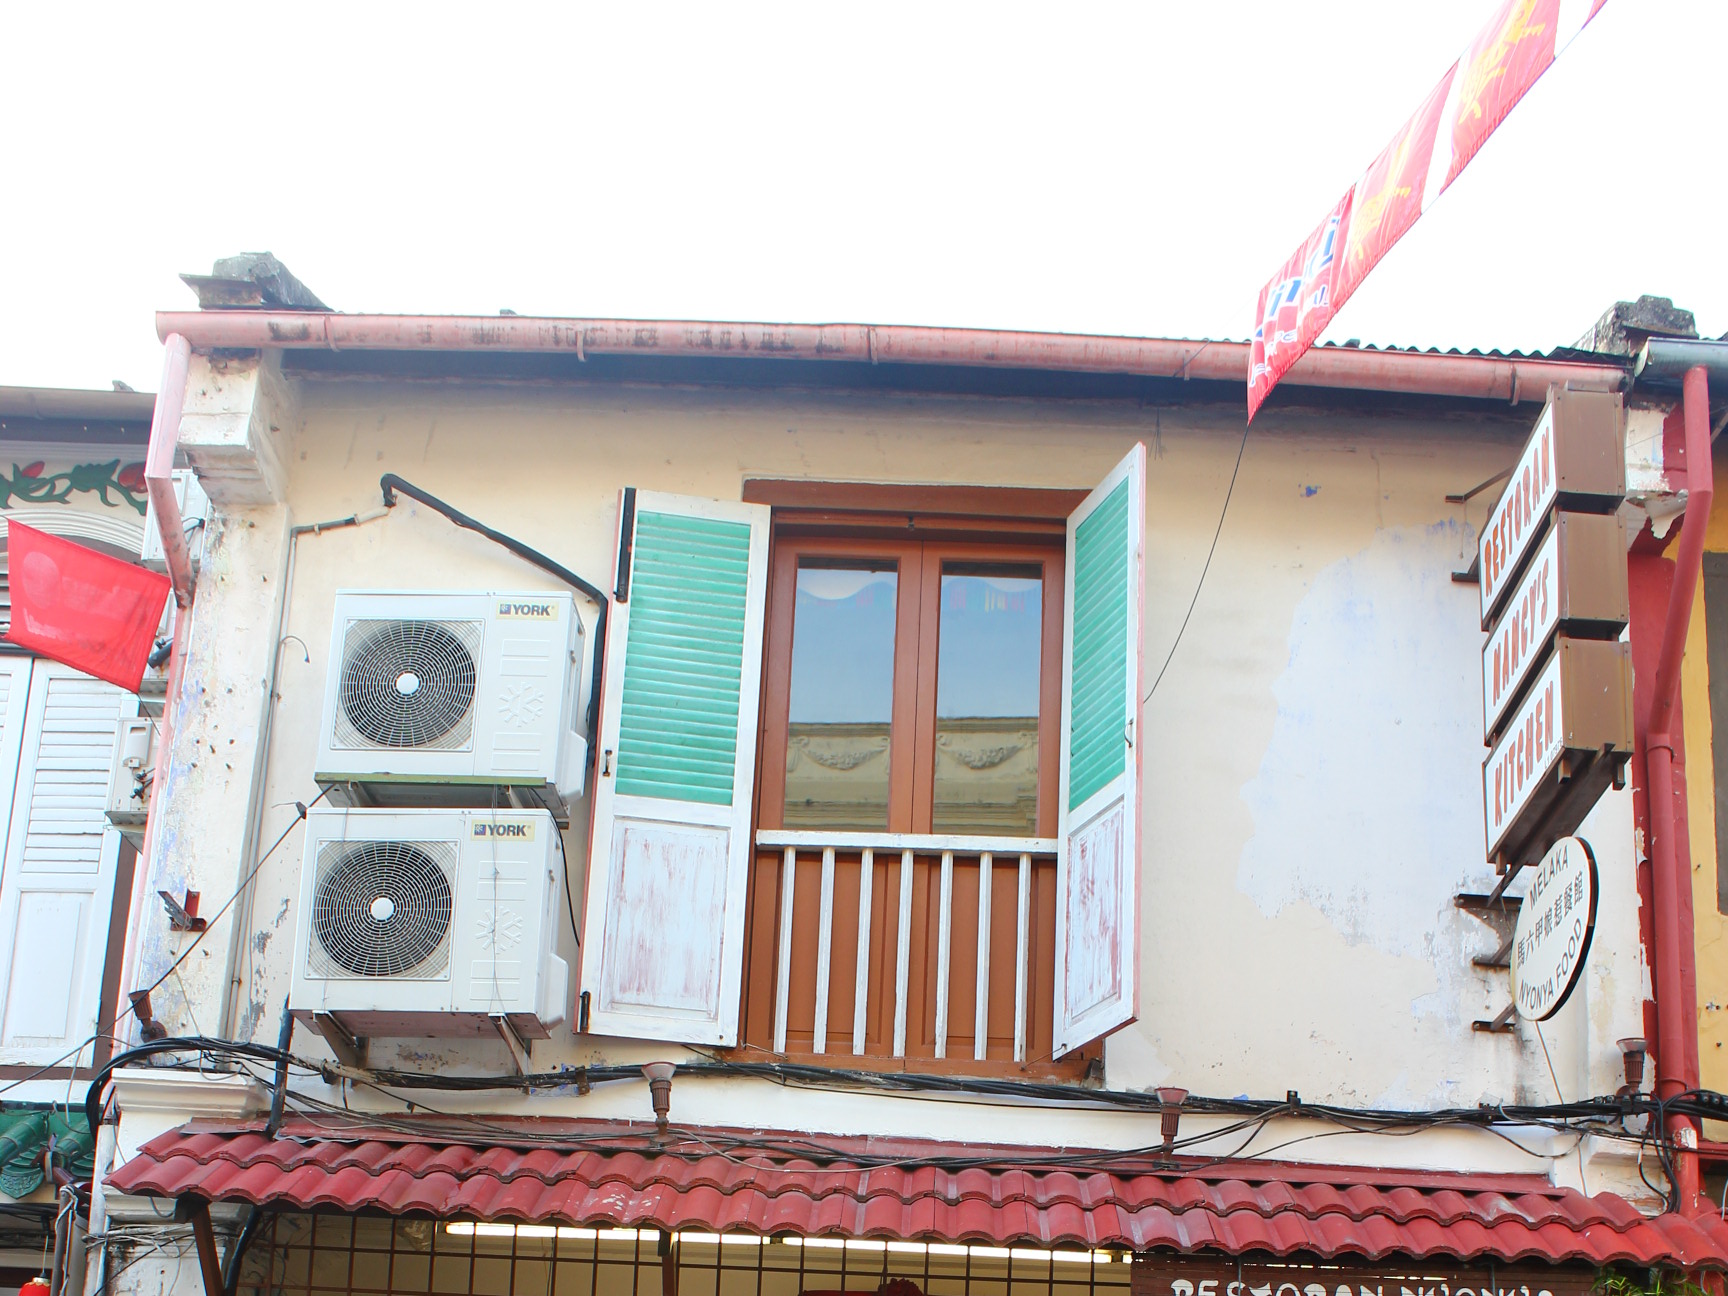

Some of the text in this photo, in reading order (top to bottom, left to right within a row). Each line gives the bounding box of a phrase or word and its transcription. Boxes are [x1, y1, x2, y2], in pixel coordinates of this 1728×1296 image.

[1484, 426, 1550, 597] RESTORAN
[513, 604, 550, 616] YORK
[1493, 557, 1549, 707] NANCY'S
[1495, 680, 1553, 827] KITCHEN
[488, 824, 526, 836] YORK
[1530, 845, 1569, 911] MELAKA
[1519, 918, 1582, 1010] NYONYA FOOD
